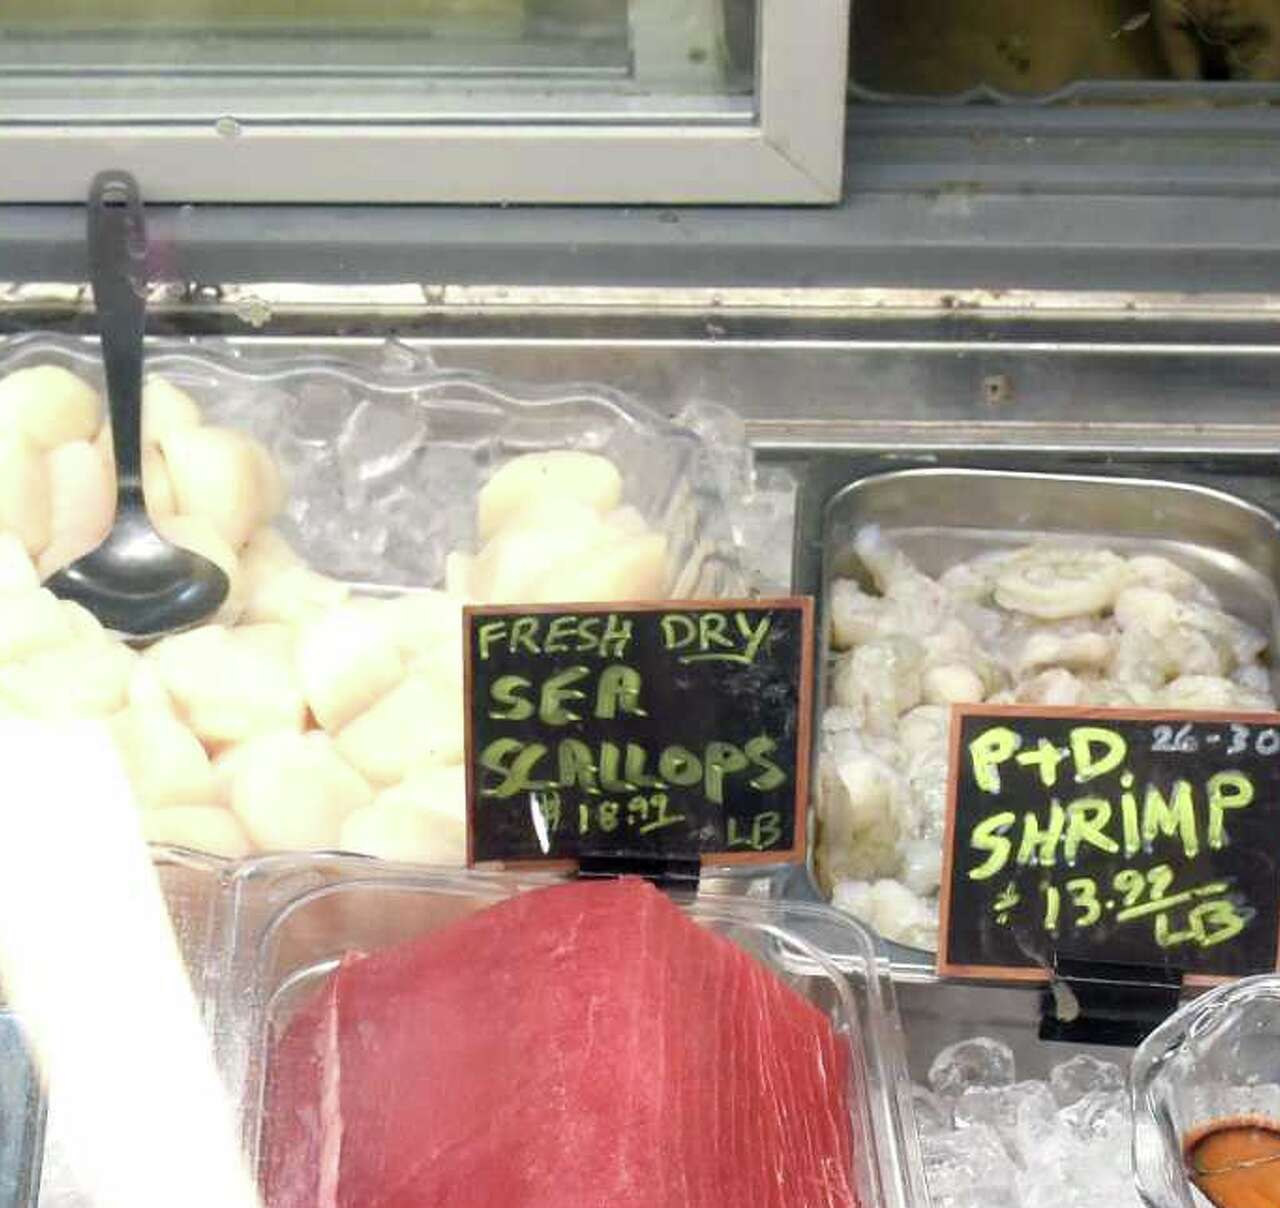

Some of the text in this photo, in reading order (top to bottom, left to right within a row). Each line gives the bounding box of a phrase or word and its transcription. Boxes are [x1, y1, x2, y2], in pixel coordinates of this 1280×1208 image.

[477, 611, 772, 664] FRESH DRY
[489, 664, 649, 727] SEA
[479, 733, 787, 804] SCALLOPS
[969, 726, 1127, 793] P+D
[728, 811, 783, 851] LB
[992, 864, 1246, 948] $13.99 LB
